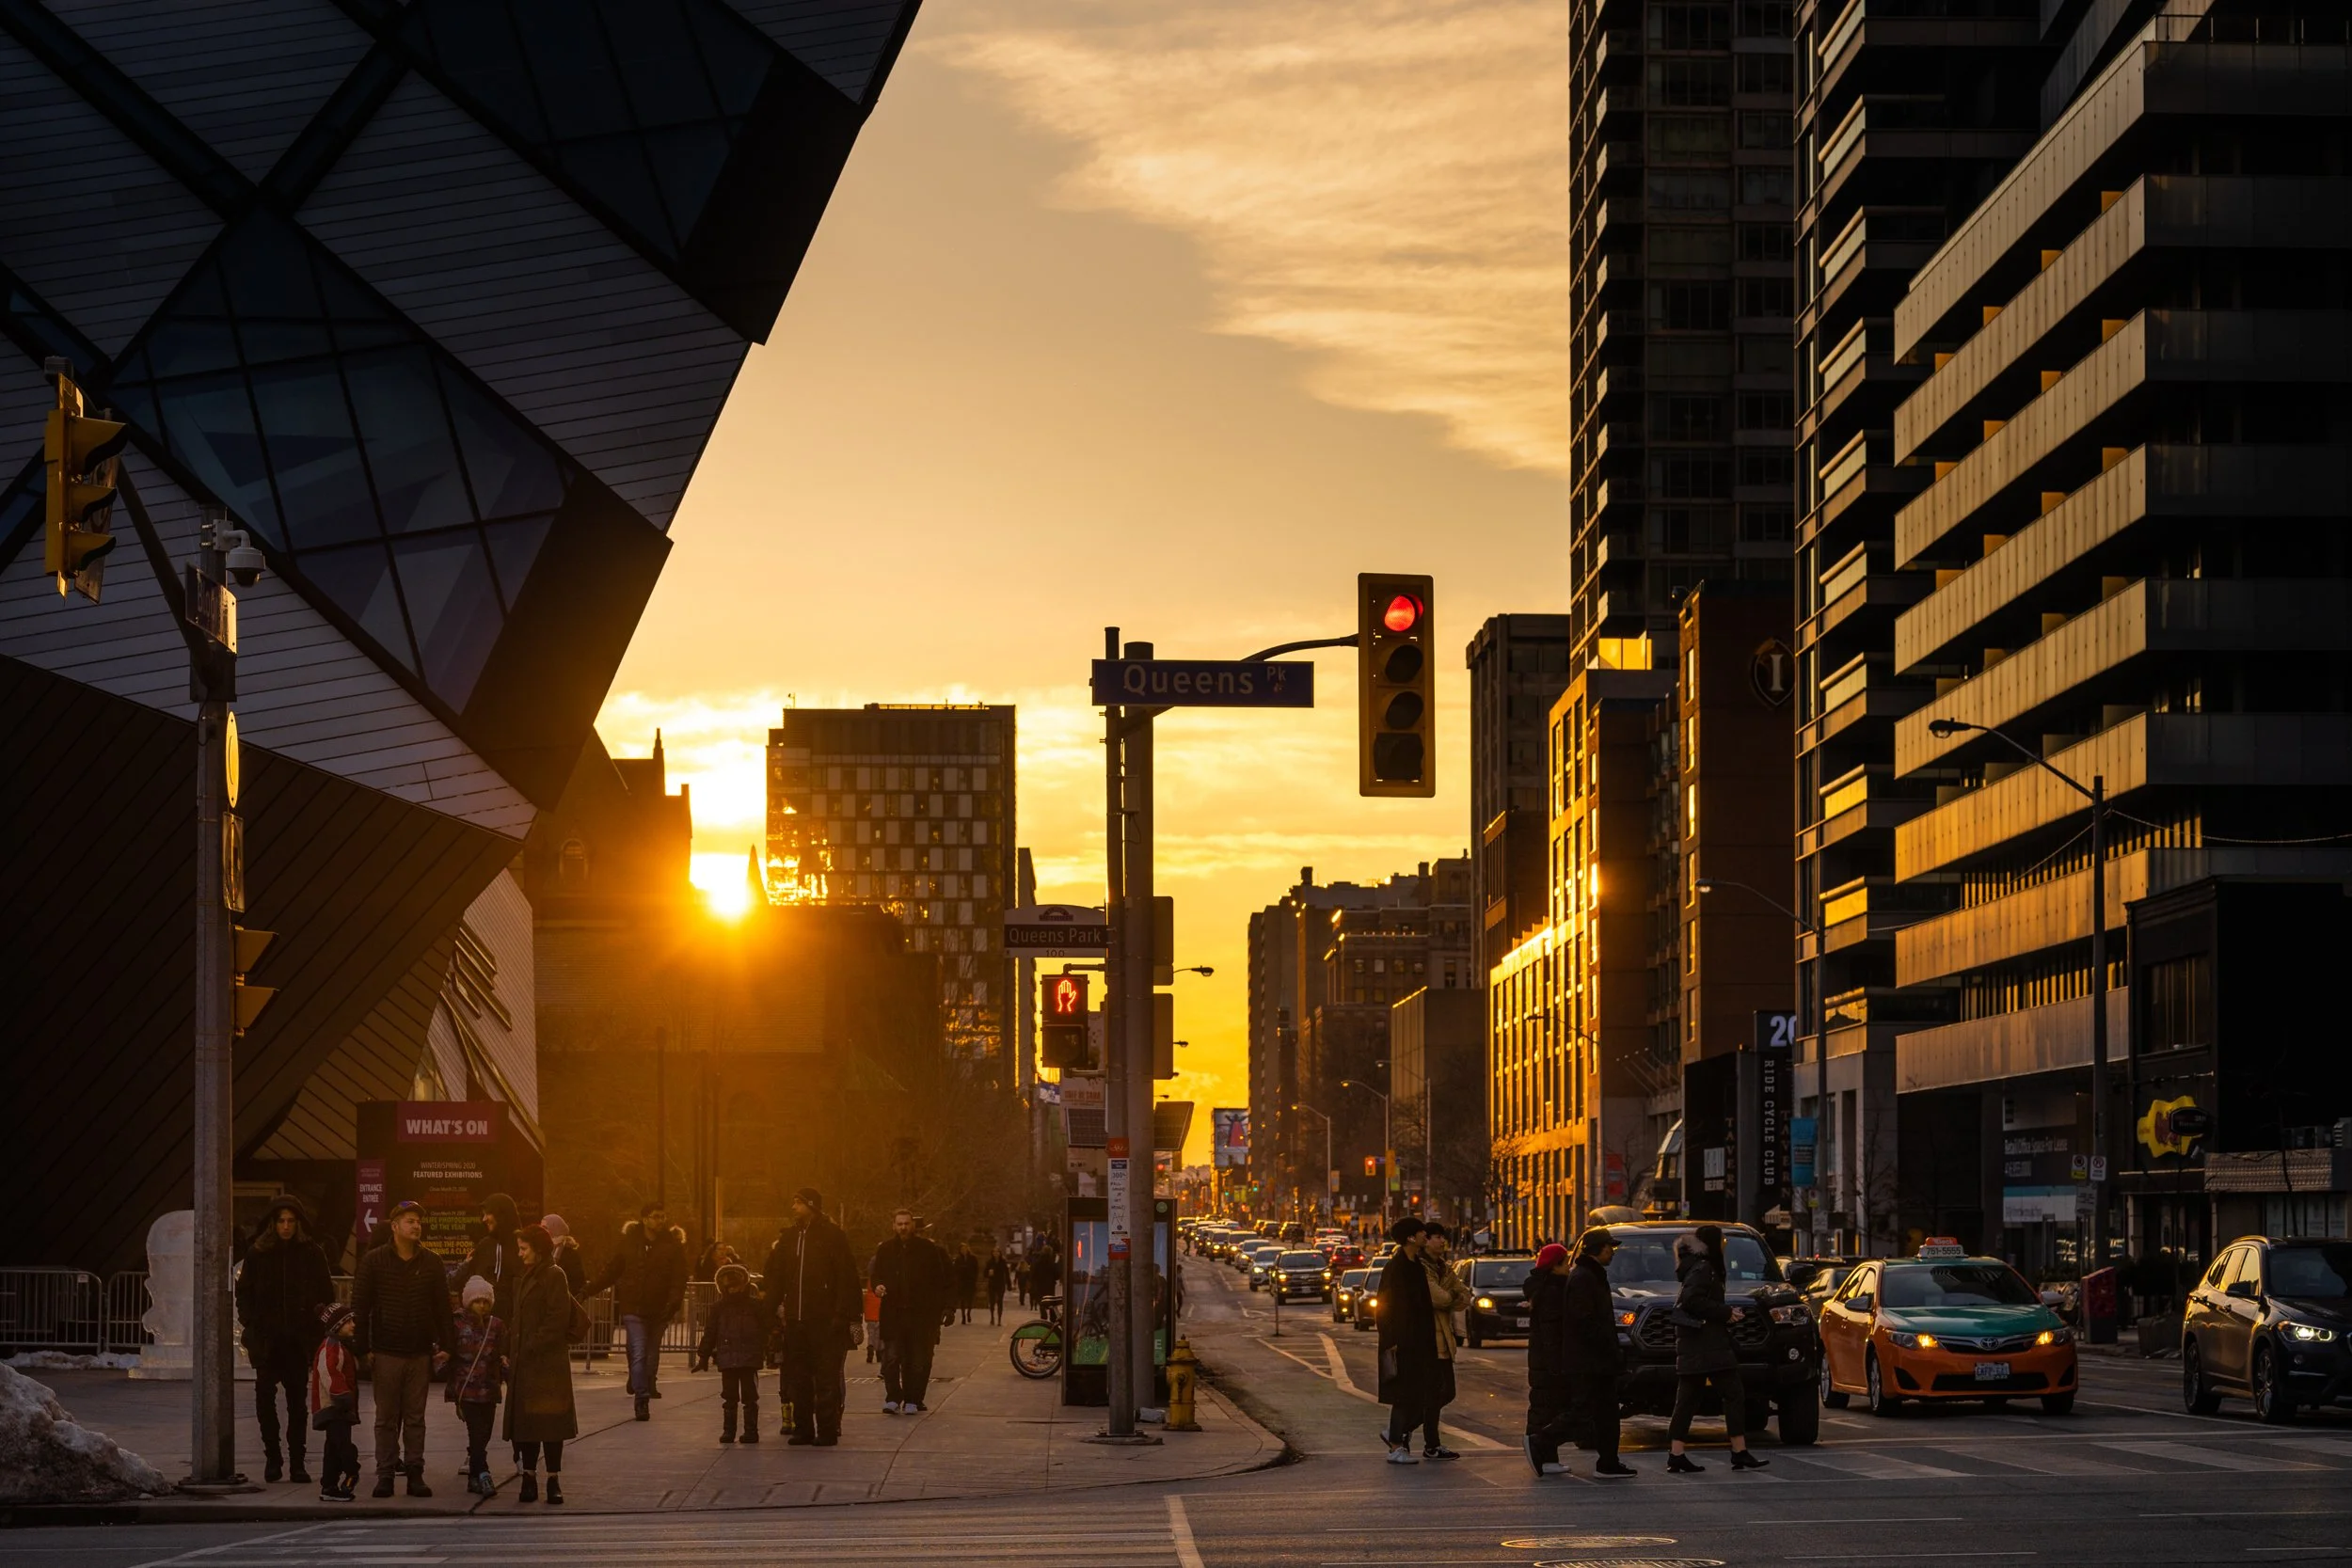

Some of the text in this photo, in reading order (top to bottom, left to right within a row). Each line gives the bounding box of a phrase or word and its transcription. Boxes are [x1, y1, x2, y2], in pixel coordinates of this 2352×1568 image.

[1122, 663, 1287, 697] Queens Pk
[1009, 927, 1102, 944] Queens Park
[405, 1119, 488, 1135] WHAT'S ON
[1763, 1059, 1775, 1186] RIDE CYCLE CLUB
[421, 1161, 462, 1170] WINTER/SPRING
[1724, 1117, 1737, 1199] TAVERN
[413, 1170, 483, 1179] FEATURED EXHIBITIONS
[359, 1183, 383, 1192] ENTRANCE
